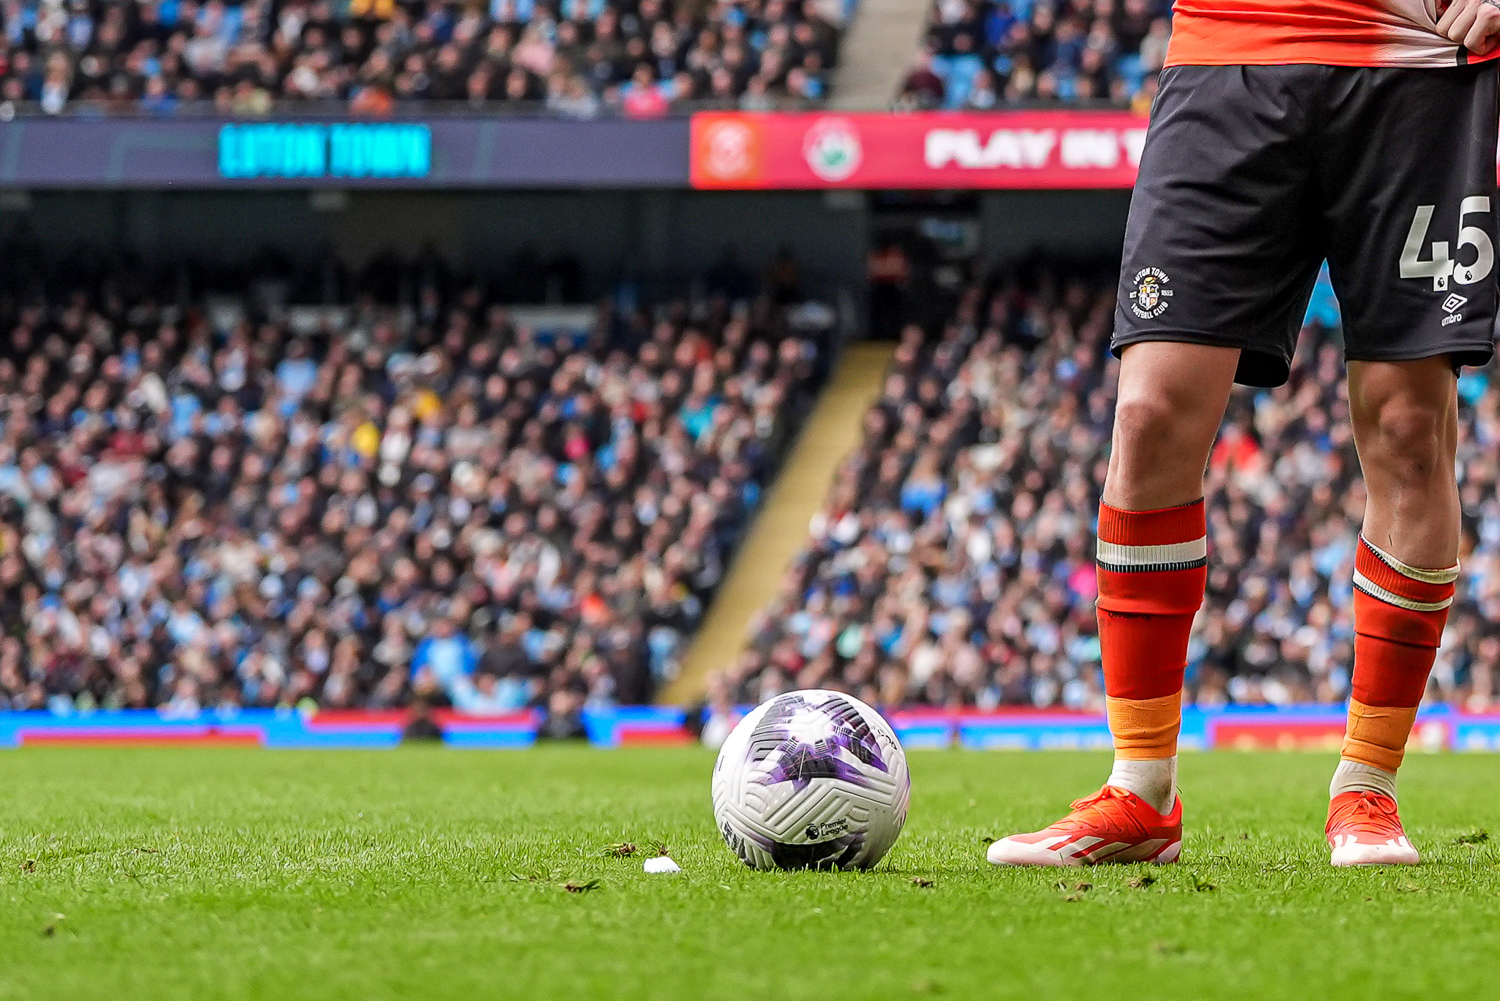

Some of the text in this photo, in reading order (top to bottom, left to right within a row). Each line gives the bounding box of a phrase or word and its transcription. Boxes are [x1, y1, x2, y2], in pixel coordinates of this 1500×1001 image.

[926, 129, 1054, 167] PLAY
[1400, 197, 1495, 292] 45
[1151, 267, 1170, 284] TOWN
[1153, 301, 1169, 316] CLUB
[820, 818, 847, 829] Premier
[821, 824, 849, 836] League
